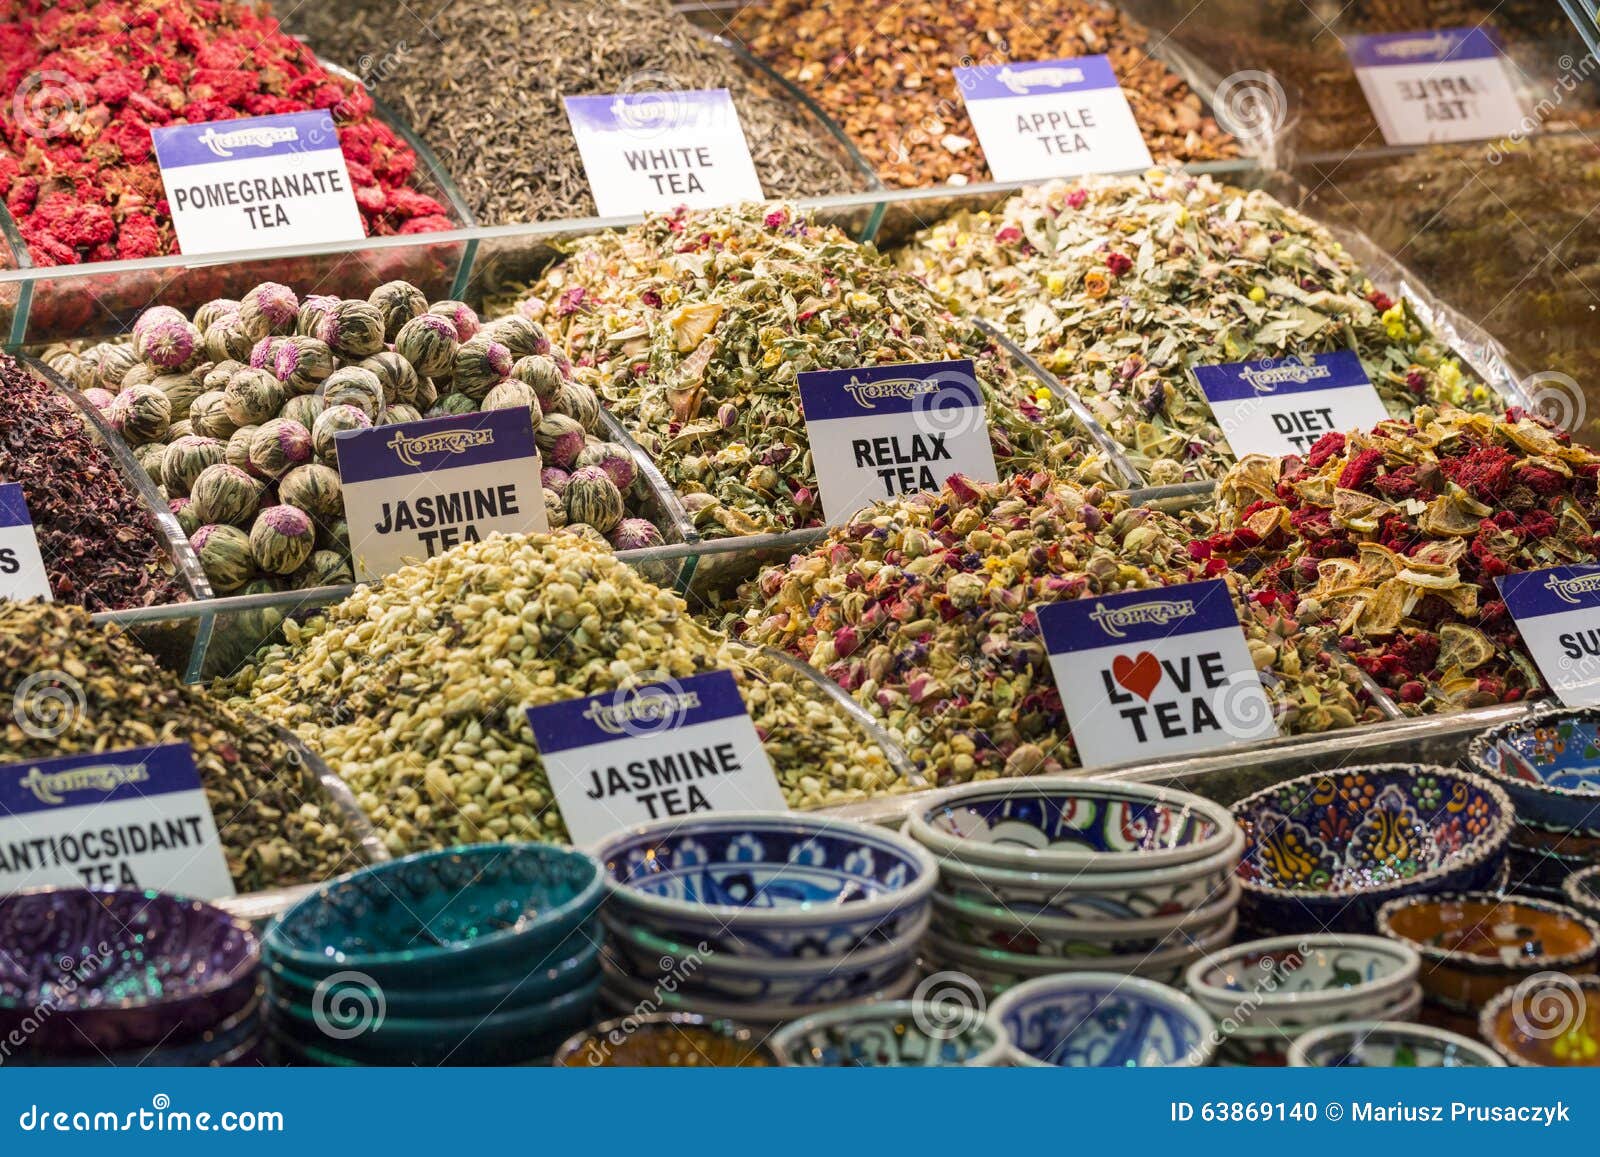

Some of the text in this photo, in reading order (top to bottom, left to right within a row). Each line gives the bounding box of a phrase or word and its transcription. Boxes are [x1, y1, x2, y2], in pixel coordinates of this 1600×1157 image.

[1016, 108, 1096, 134] APPLE
[623, 147, 713, 171] WHITE
[1037, 133, 1092, 156] TEA
[174, 169, 344, 211] POMEGRANATE
[648, 172, 705, 196] TEA
[243, 203, 291, 230] TEA
[1270, 407, 1336, 435] DIET
[851, 431, 953, 469] RELAX
[876, 465, 940, 497] TEA
[374, 483, 520, 535] JASMINE
[1559, 627, 1600, 660] SU
[1119, 696, 1223, 744] TEA
[586, 742, 742, 800] JASMINE
[636, 784, 714, 820] TEA
[0, 816, 203, 874] ANTIOCSIDANT
